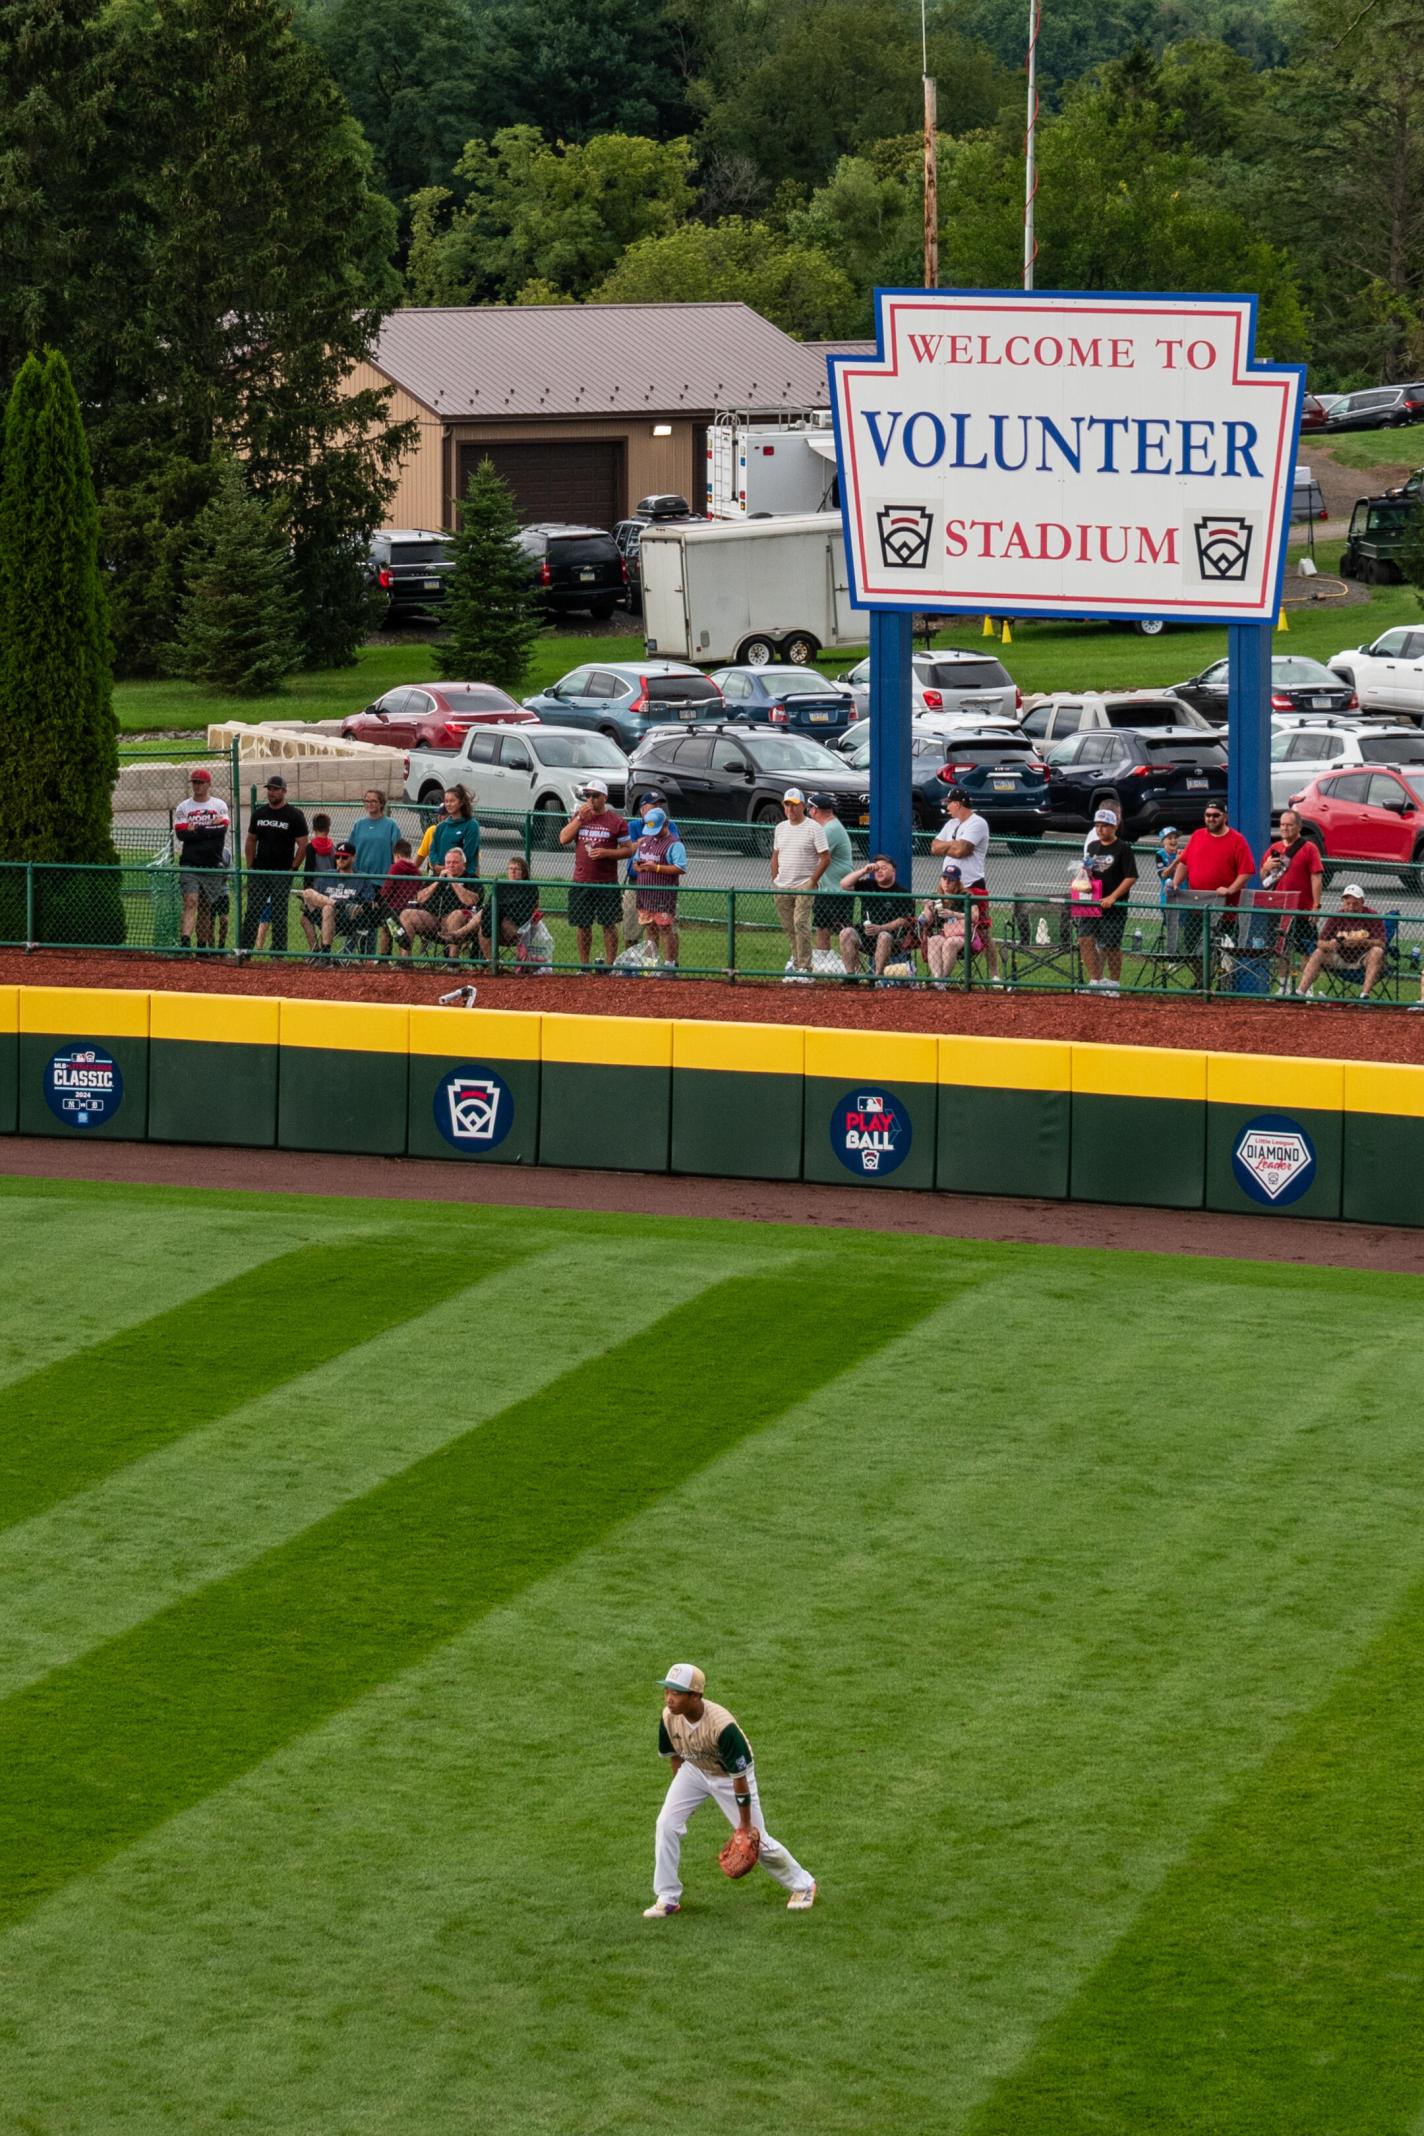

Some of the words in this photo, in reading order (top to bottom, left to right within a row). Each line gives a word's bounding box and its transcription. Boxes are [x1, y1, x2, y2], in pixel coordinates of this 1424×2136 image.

[907, 333, 1135, 368] WELCOME
[1156, 338, 1217, 371] TO
[860, 410, 1264, 478] VOLUNTEER
[945, 519, 1179, 565] STADIUM
[256, 819, 289, 830] ROGUE
[54, 1069, 113, 1088] CLASSIC
[75, 1091, 91, 1099] 2024
[846, 1112, 894, 1132] PLAY
[846, 1130, 894, 1151] BALL
[1271, 1139, 1295, 1147] League
[1247, 1145, 1299, 1162] DIAMOND
[1255, 1156, 1293, 1172] Leader
